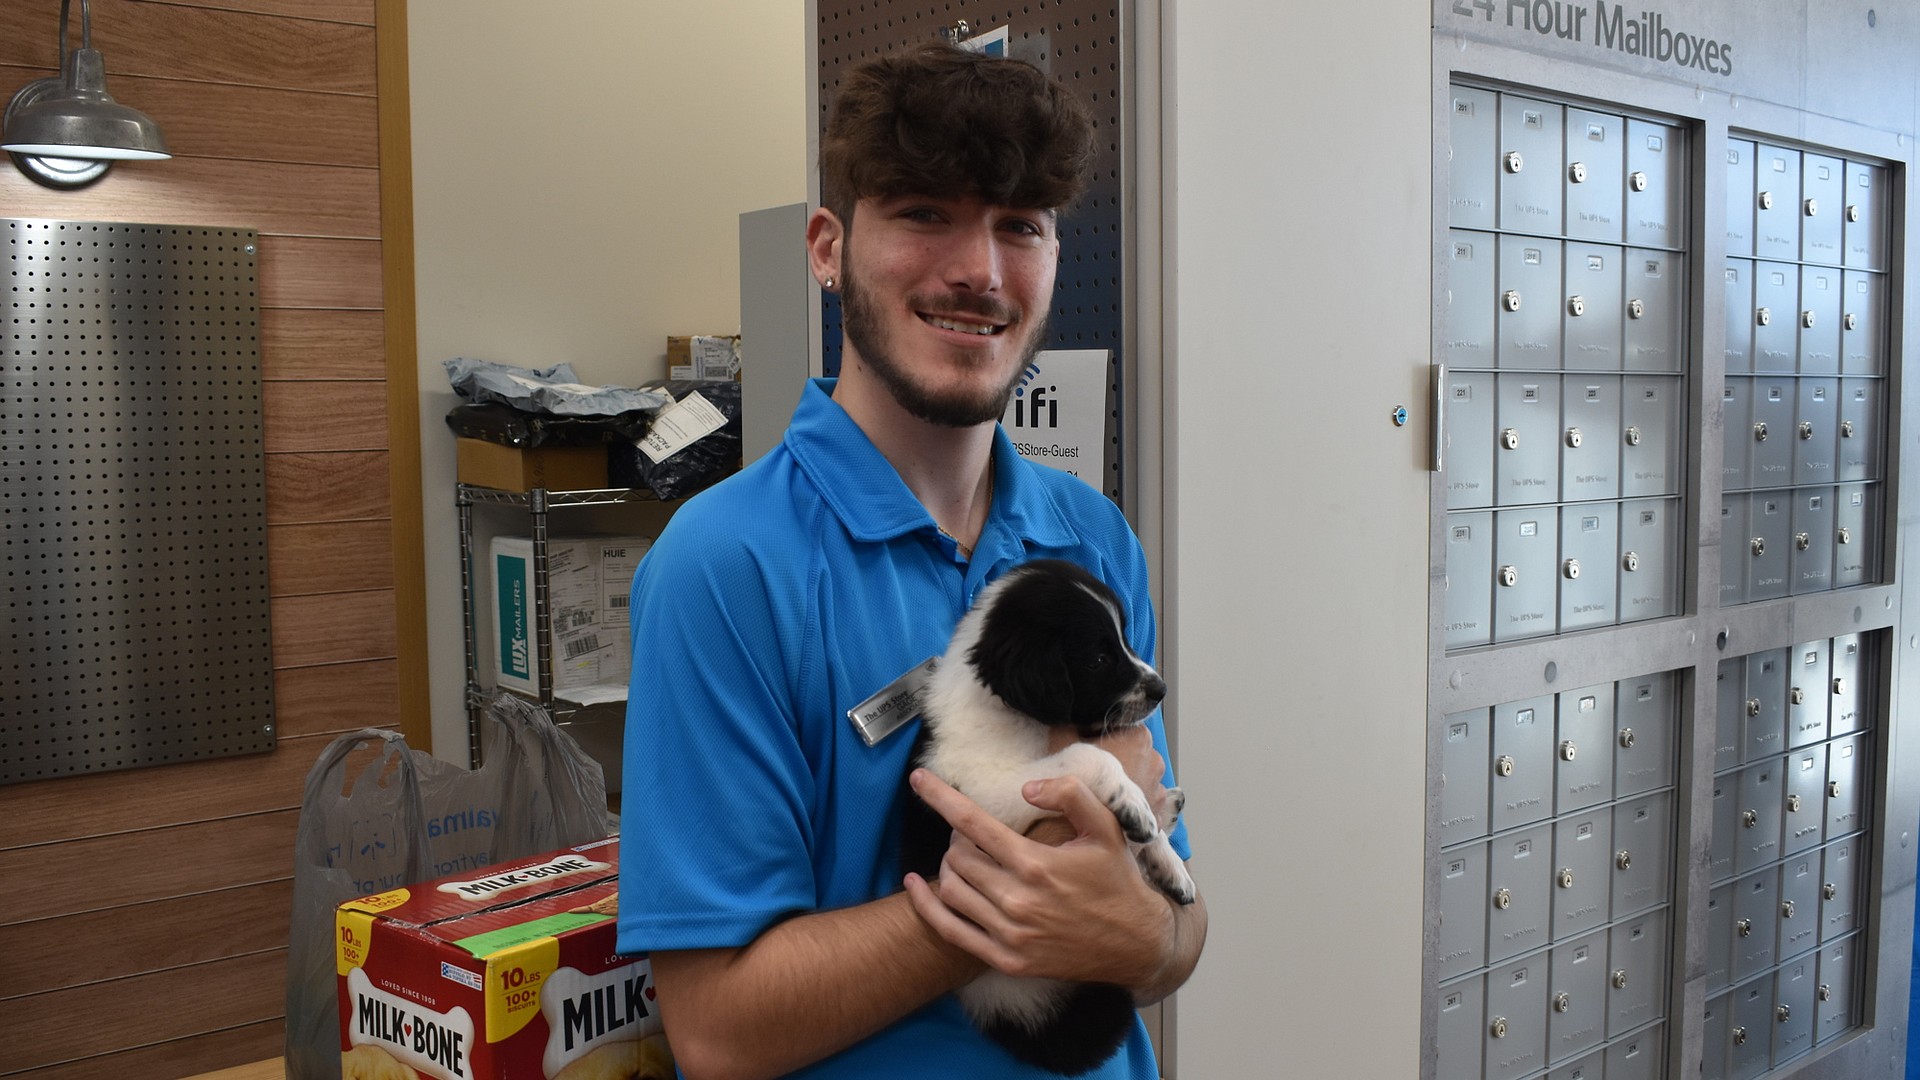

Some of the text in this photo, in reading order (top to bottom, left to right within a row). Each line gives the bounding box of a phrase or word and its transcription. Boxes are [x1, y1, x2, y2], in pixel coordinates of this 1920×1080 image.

[1506, 0, 1732, 77] Hour Mailboxes
[1458, 103, 1467, 112] 201
[1457, 247, 1466, 255] 211
[1457, 389, 1466, 397] 221
[1015, 385, 1058, 428] ifi
[603, 548, 626, 558] HUIE
[512, 579, 527, 674] LUX MAILERS
[864, 711, 878, 722] The
[877, 701, 891, 714] UPS
[1518, 844, 1527, 852] 252
[1451, 863, 1460, 871] 251
[458, 859, 592, 895] MILK BONE
[341, 926, 353, 943] 10
[343, 946, 359, 959] 100+
[501, 967, 541, 990] 10 LBS
[1514, 972, 1523, 980] 262
[381, 979, 436, 1005] LOVED SINCE 1908
[506, 990, 536, 1007] 100+
[507, 1000, 536, 1014] BISCUITS
[1447, 997, 1456, 1006] 261
[562, 974, 649, 1052] MILK
[358, 993, 464, 1078] MILK BONE
